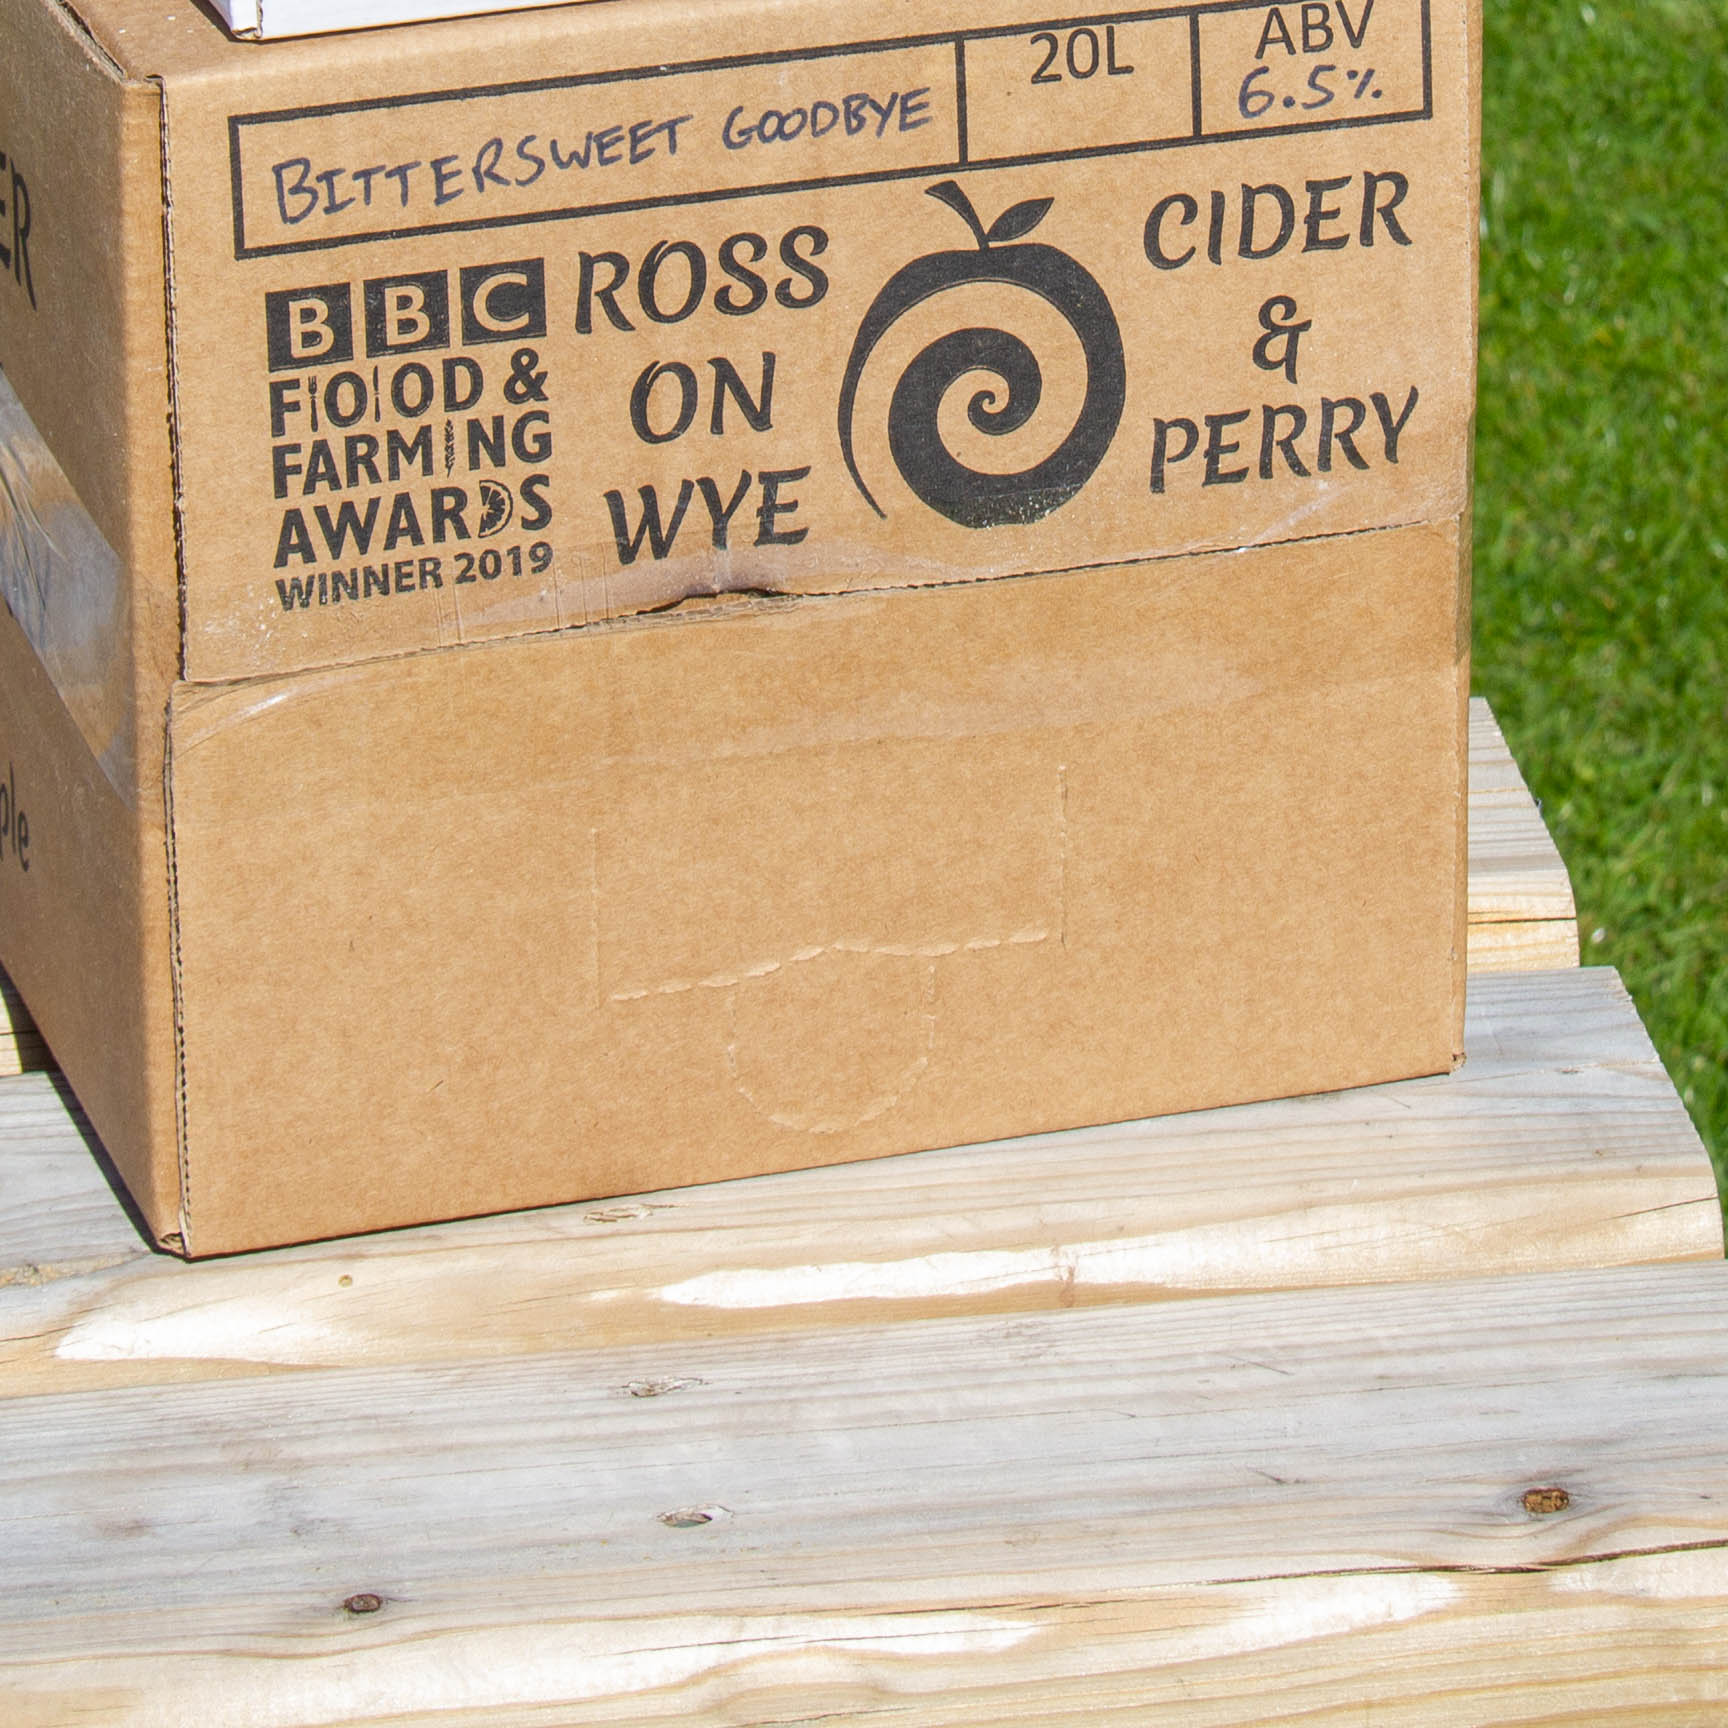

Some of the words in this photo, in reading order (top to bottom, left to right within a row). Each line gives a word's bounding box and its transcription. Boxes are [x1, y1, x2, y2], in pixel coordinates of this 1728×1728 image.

[1029, 26, 1134, 86] 20L
[1238, 64, 1383, 119] 6.5%
[271, 114, 693, 226] BITTERSWEET
[721, 87, 933, 151] GOODBYE
[1143, 170, 1412, 270] CIDER
[276, 264, 540, 365] BBC
[574, 225, 830, 335] ROSS
[1251, 295, 1312, 384] &
[269, 355, 484, 438] FOOD
[502, 347, 549, 405] &
[629, 351, 776, 445] ON
[1150, 385, 1419, 495] PERRY
[271, 409, 553, 500] FARMING
[272, 473, 554, 569] AWARDS
[603, 465, 811, 565] WYE
[275, 555, 443, 612] WINNER
[453, 540, 554, 585] 2019
